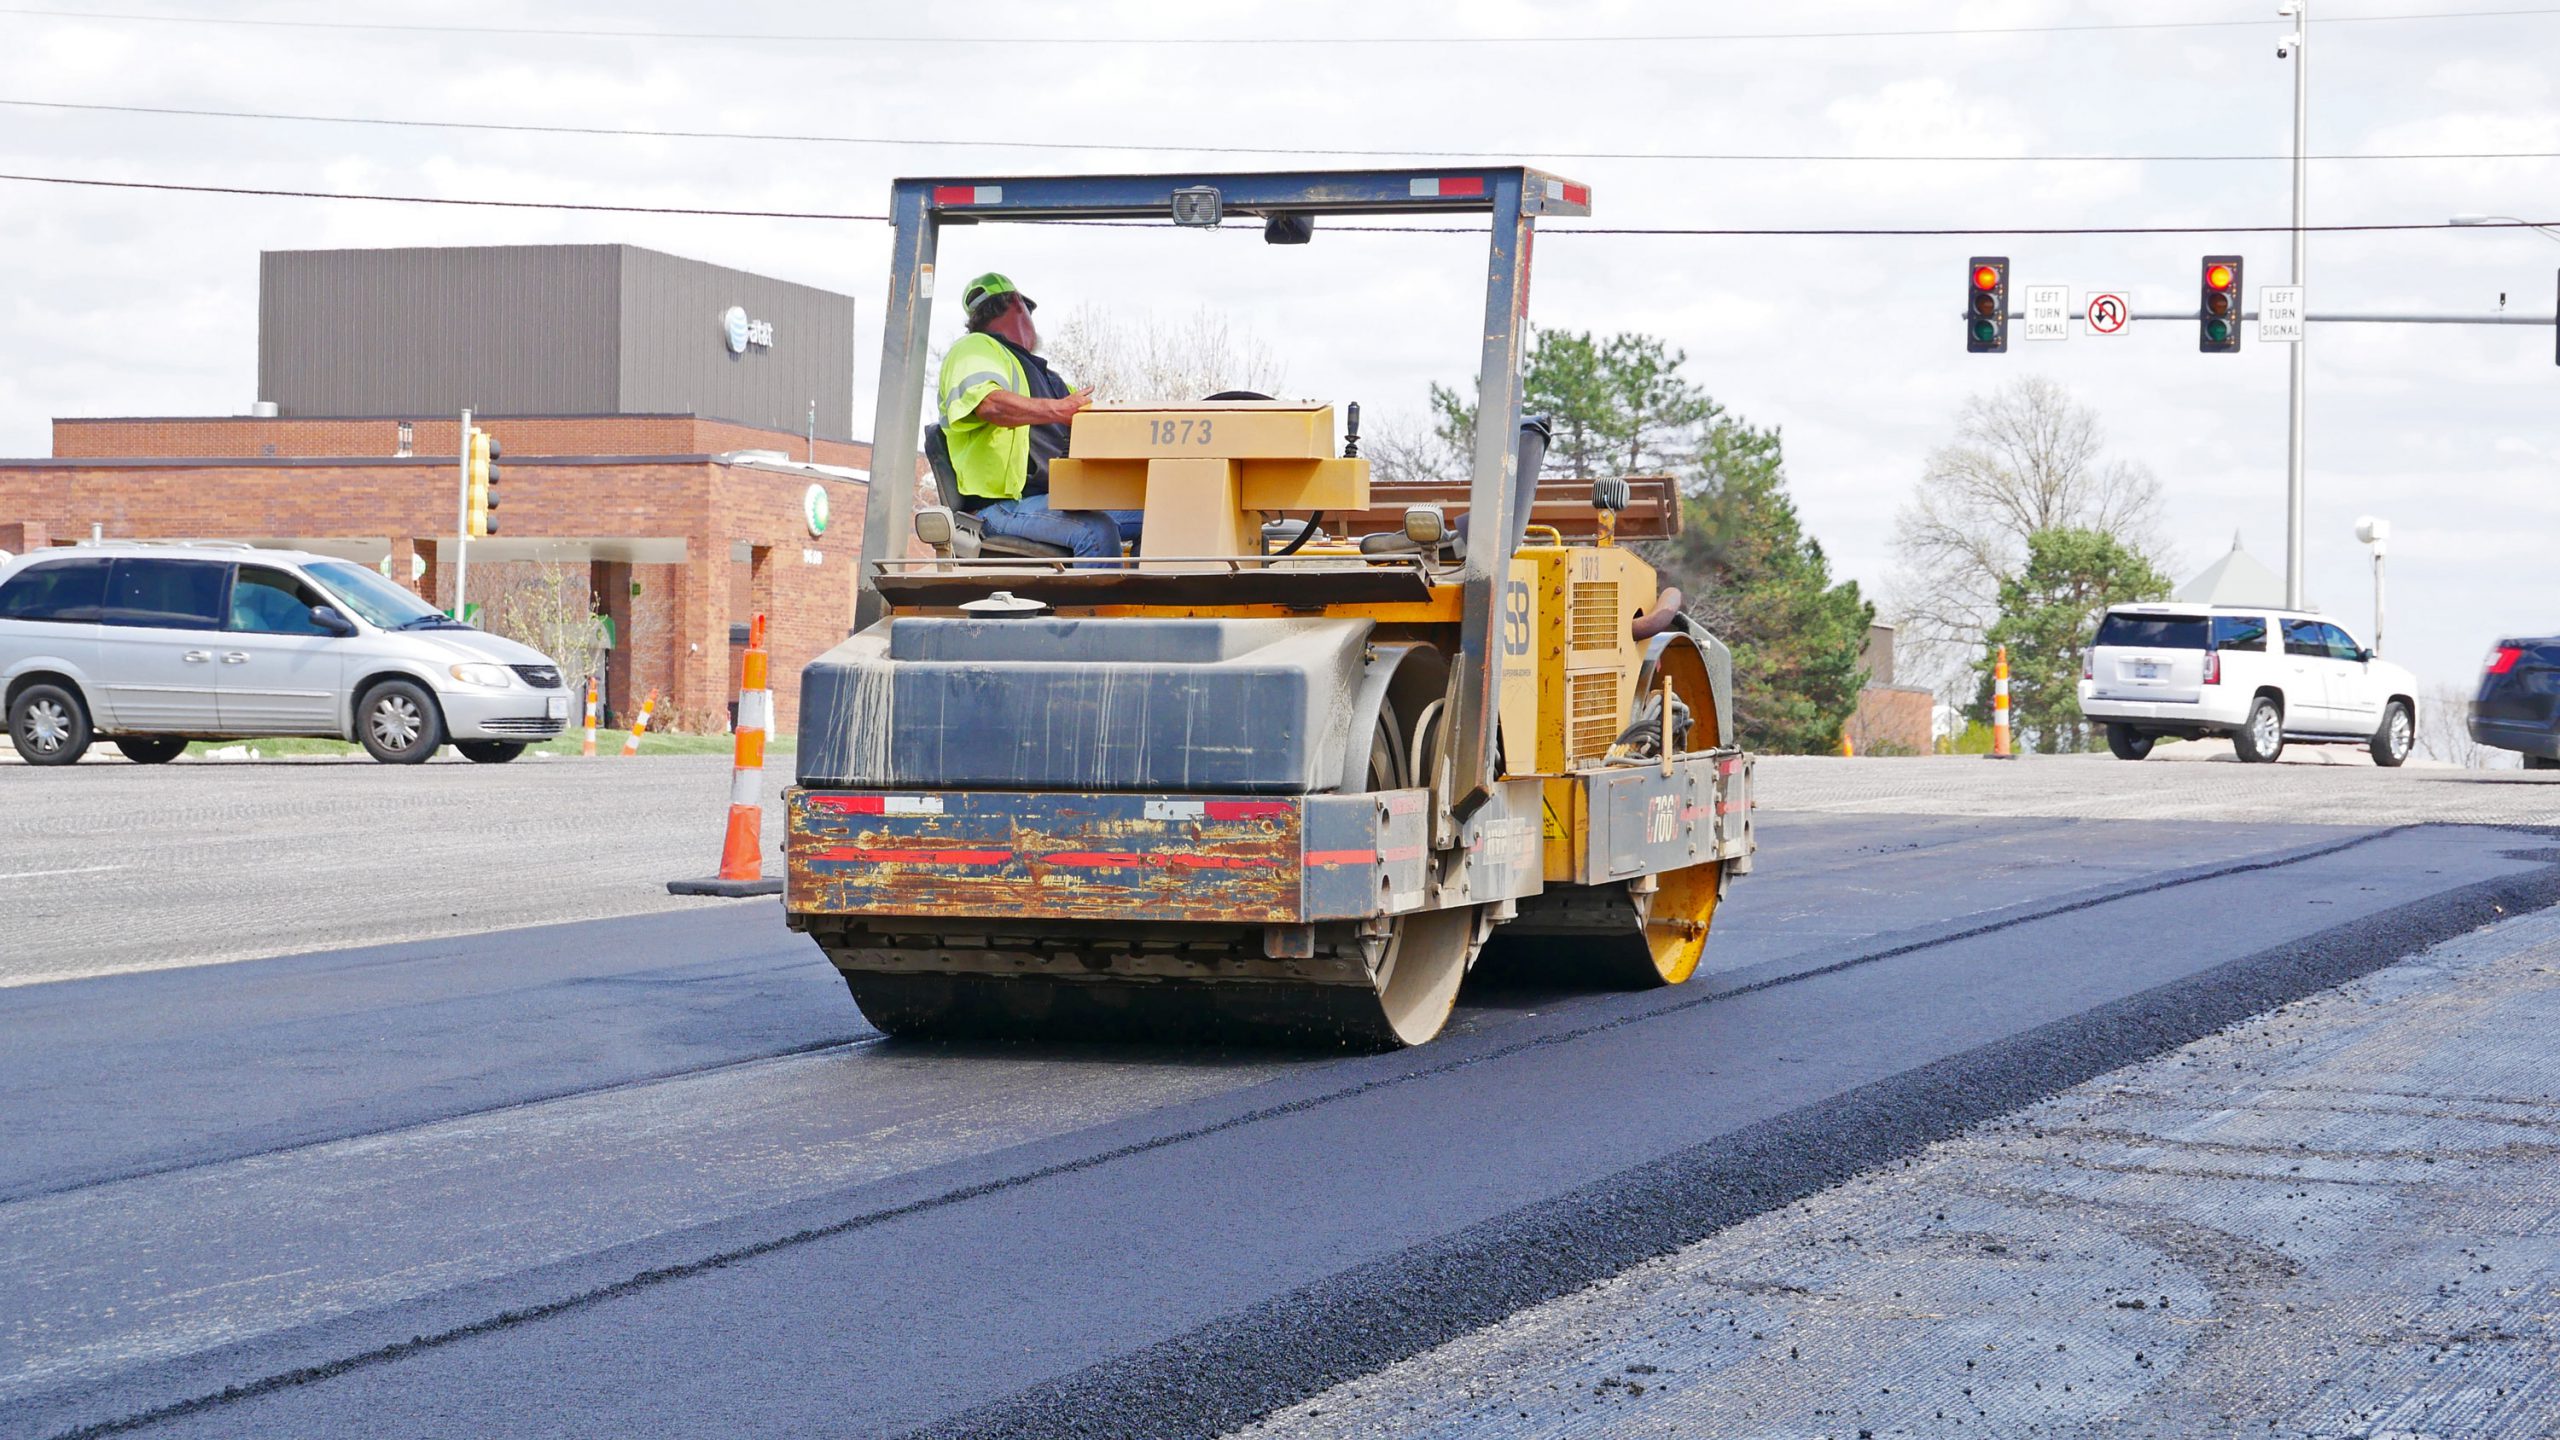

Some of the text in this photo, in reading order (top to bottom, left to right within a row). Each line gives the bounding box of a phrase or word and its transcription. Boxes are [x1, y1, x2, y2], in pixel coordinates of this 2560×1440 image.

[2034, 291, 2060, 303] LEFT
[2269, 292, 2295, 303] LEFT
[2033, 308, 2061, 319] TURN
[2269, 308, 2296, 320] TURN
[2028, 324, 2065, 335] SIGNAL
[2262, 324, 2301, 336] SIGNAL
[1149, 419, 1213, 446] 1873
[1580, 556, 1600, 580] 1873
